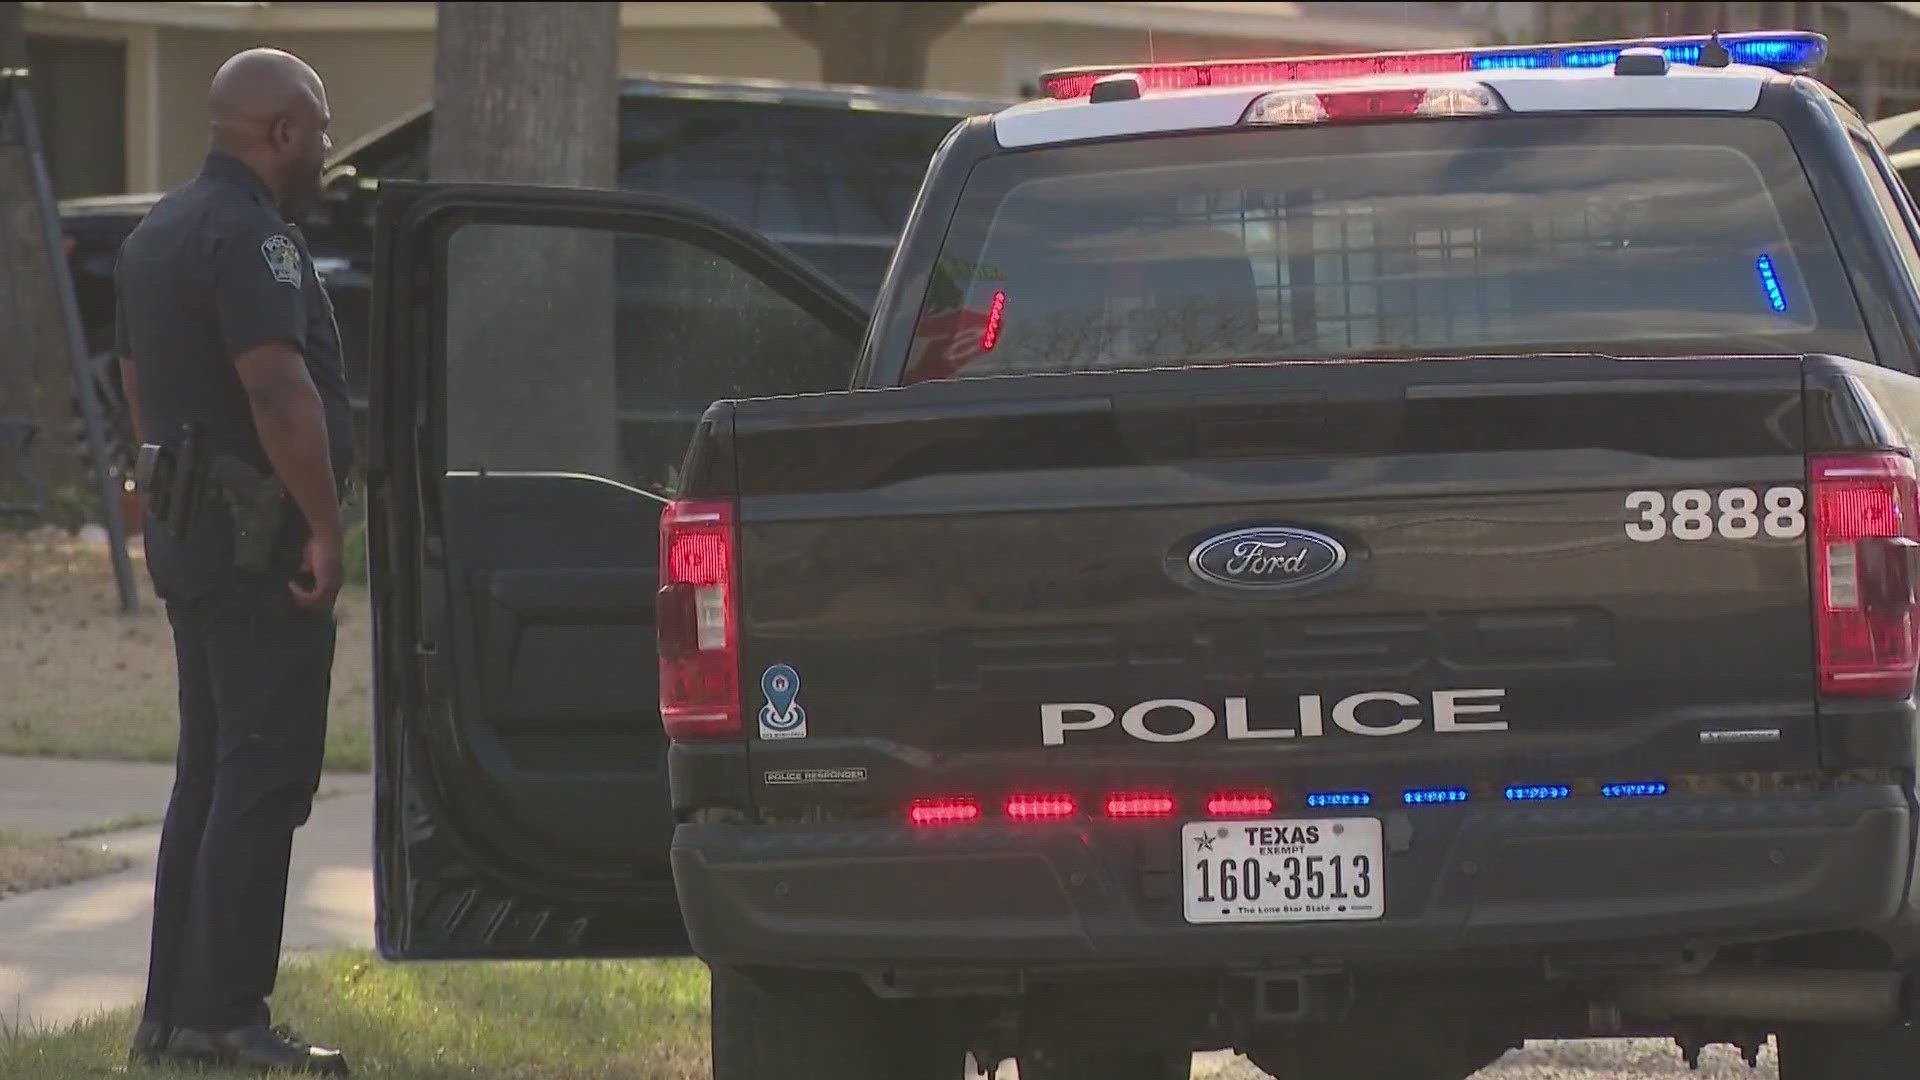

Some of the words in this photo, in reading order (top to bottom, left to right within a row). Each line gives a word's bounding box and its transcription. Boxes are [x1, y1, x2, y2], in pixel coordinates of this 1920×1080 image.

[1624, 487, 1806, 542] 3888
[1226, 541, 1308, 574] Ford
[1040, 689, 1508, 746] POLICE
[767, 772, 802, 781] POLICE
[804, 770, 864, 781] RESPONDER
[1244, 825, 1320, 846] TEXAS
[1259, 846, 1306, 856] EXEMPT
[1283, 905, 1302, 913] Star
